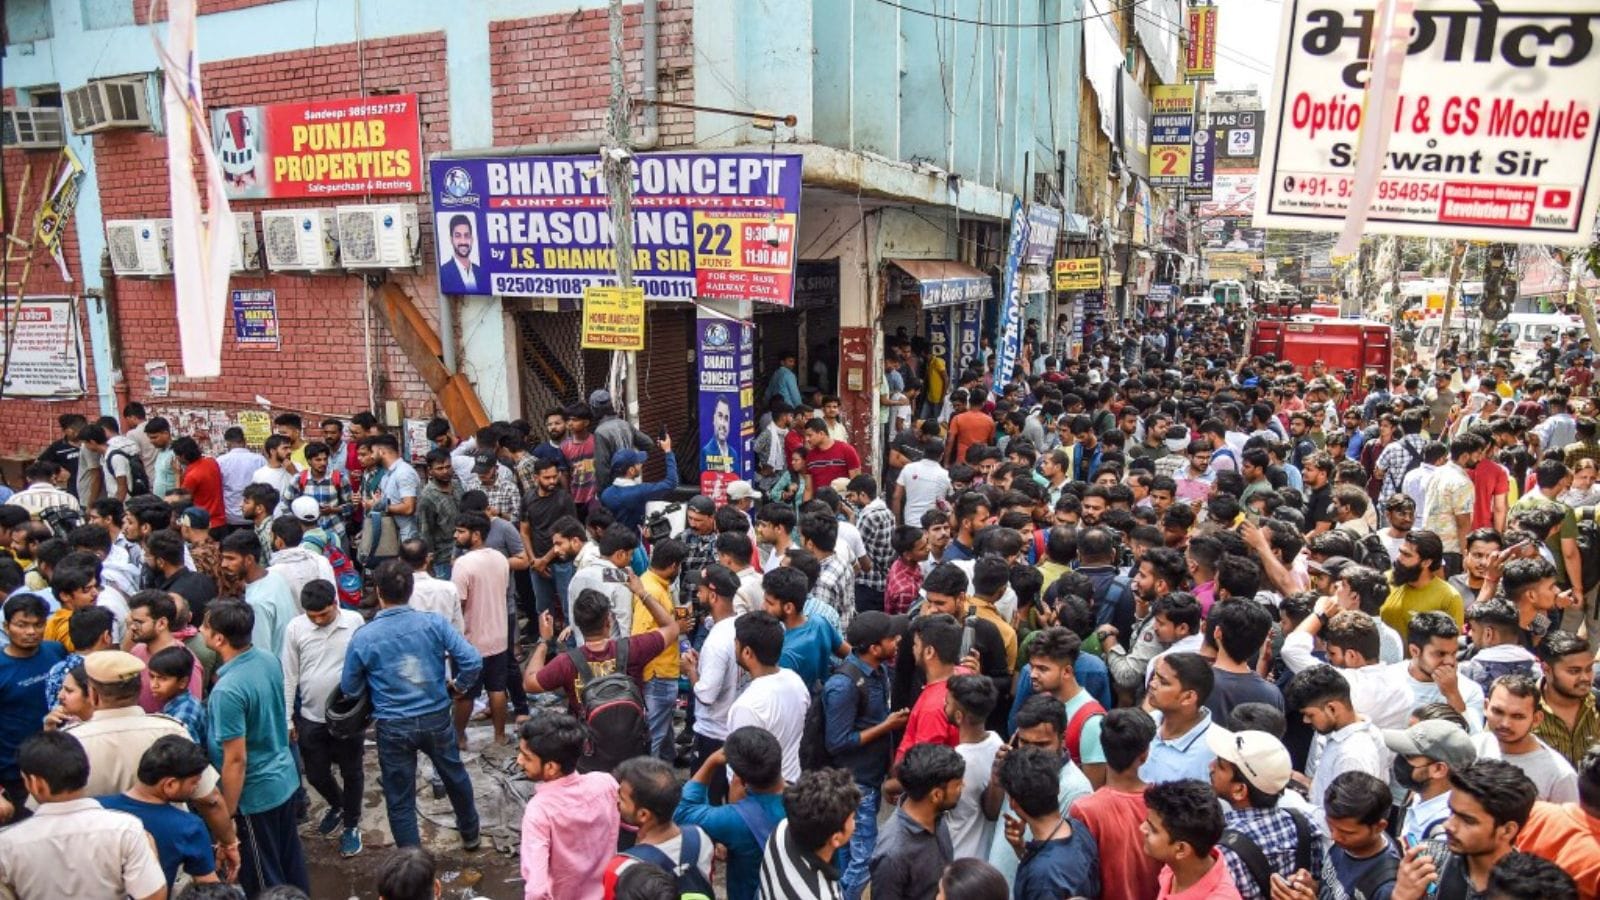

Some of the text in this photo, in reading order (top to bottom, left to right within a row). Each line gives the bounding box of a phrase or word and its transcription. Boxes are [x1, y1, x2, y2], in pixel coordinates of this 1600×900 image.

[304, 110, 346, 121] Sandeep:
[1216, 115, 1237, 126] IAS
[1292, 92, 1590, 140] Optiol & GS Module
[291, 119, 387, 152] PUNJAB
[1233, 131, 1251, 144] 29
[273, 149, 412, 182] PROPERTIES
[1161, 152, 1176, 175] 2
[1329, 142, 1549, 177] Swant Sir
[516, 197, 556, 206] UNIT
[562, 197, 584, 206] OF
[687, 196, 725, 206] PVT.
[731, 197, 772, 207] LTD.
[696, 223, 732, 256] 22
[491, 249, 505, 260] by
[510, 248, 540, 269] J.S.
[655, 249, 691, 271] SIR
[700, 258, 732, 268] JUNE
[745, 248, 788, 266] 11:00 AM
[1057, 261, 1078, 271] PG
[707, 272, 727, 281] FOR
[700, 370, 737, 385] CONCEPT
